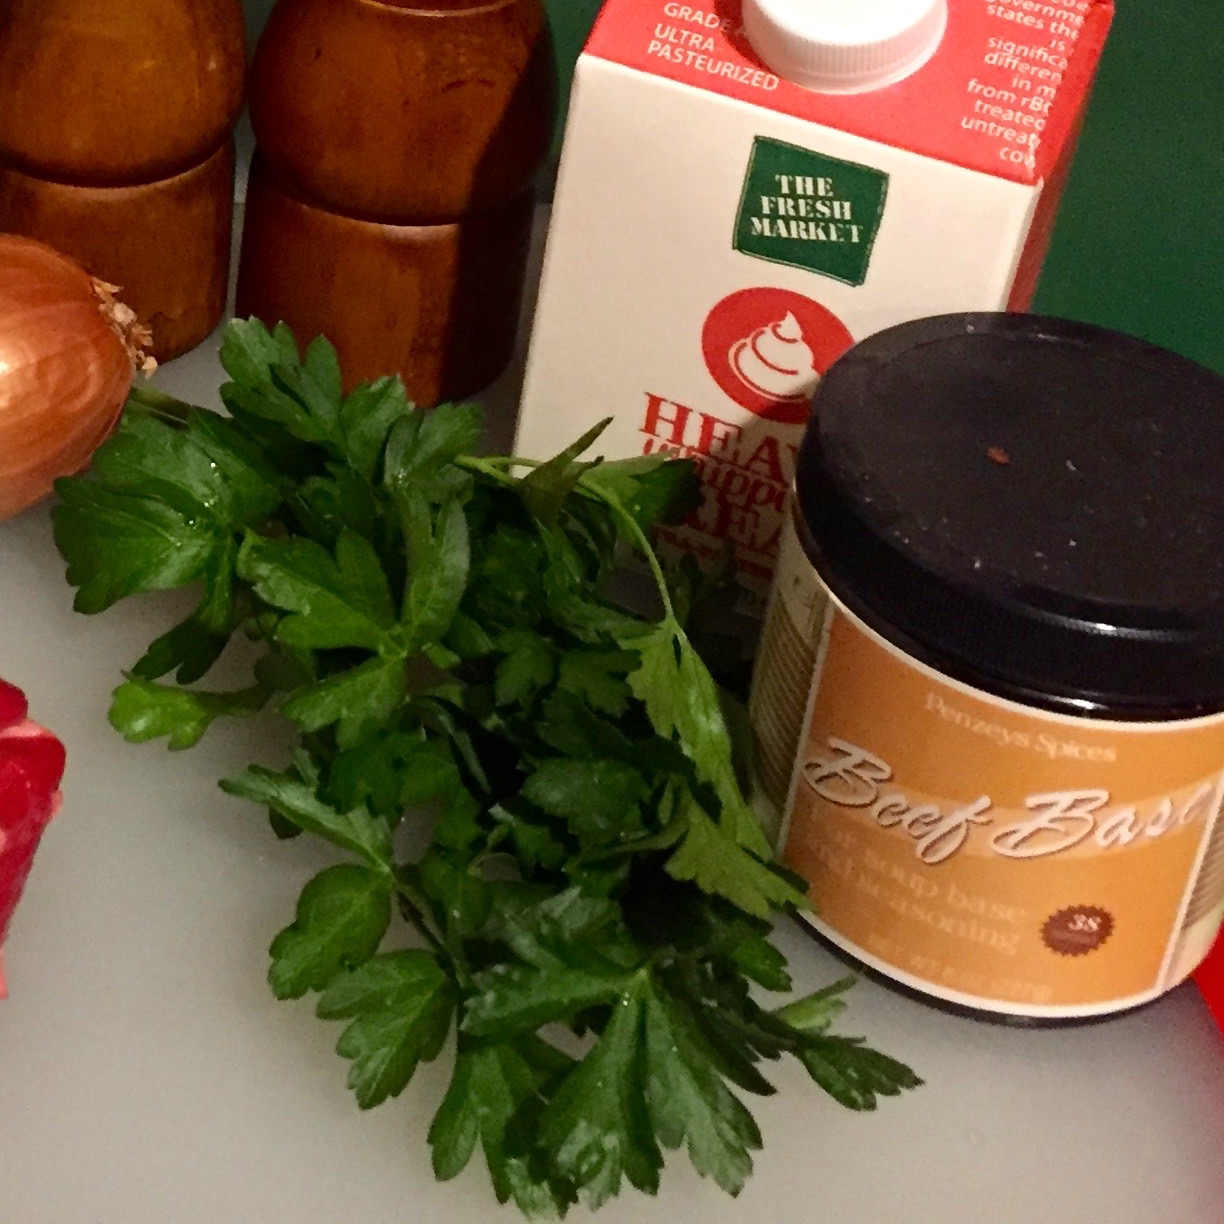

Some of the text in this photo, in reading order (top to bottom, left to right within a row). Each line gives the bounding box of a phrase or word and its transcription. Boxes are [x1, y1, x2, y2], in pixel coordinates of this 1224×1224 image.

[663, 2, 732, 32] GRADE
[986, 5, 1044, 30] states
[654, 22, 715, 52] ULTRA
[1049, 39, 1066, 52] is
[647, 39, 780, 91] PASTEURIZED
[966, 78, 1017, 104] from
[1011, 75, 1032, 91] in
[774, 173, 834, 198] THE
[759, 194, 852, 221] FRESH
[750, 216, 864, 244] MARKET
[639, 392, 799, 490] HEA
[803, 735, 993, 865] Beef
